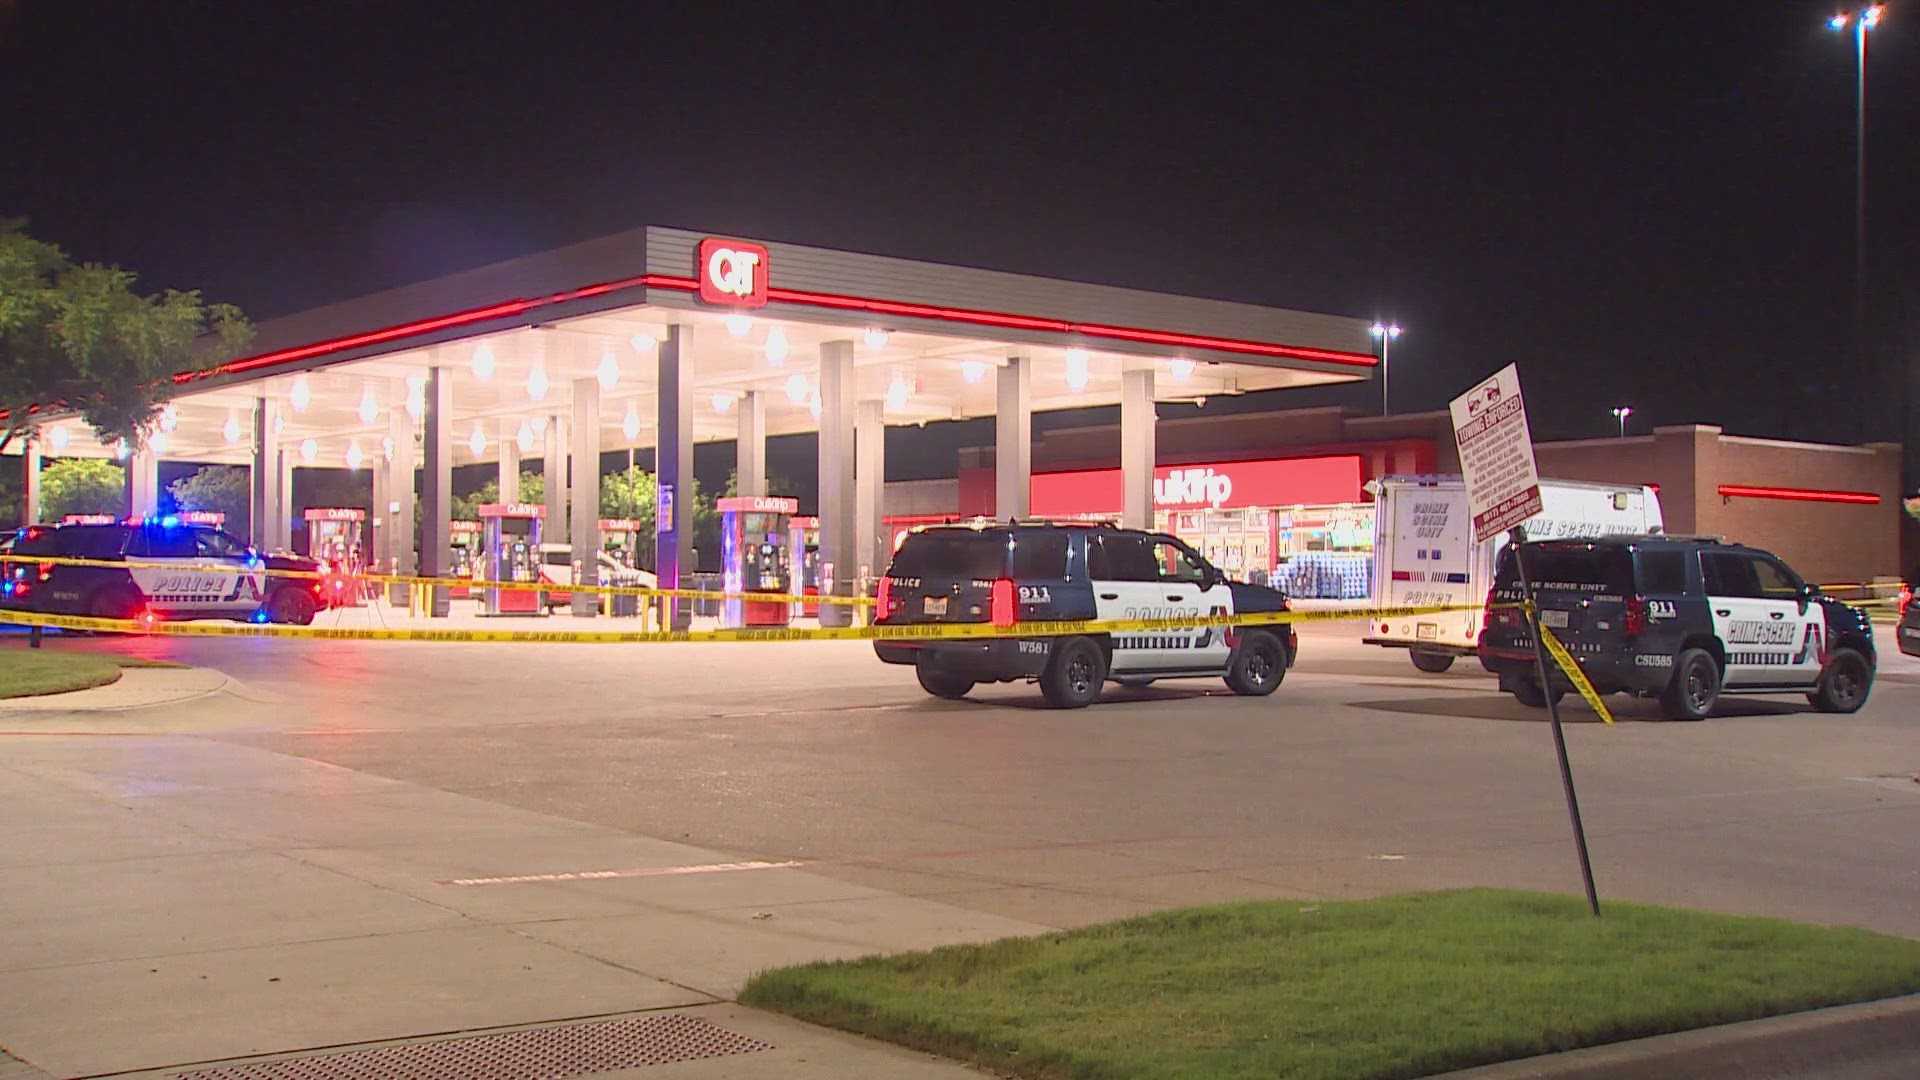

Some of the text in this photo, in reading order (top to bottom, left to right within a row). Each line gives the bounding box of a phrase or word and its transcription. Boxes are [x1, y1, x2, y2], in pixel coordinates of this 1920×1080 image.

[708, 248, 759, 297] QT
[1458, 396, 1520, 444] TOWING ENFORCED
[1153, 468, 1232, 509] uikTrip
[153, 575, 227, 592] POLICE
[1019, 586, 1050, 599] 911
[1649, 600, 1676, 613] 911
[1727, 620, 1796, 645] CRIME SCENE
[1018, 640, 1049, 654] W581
